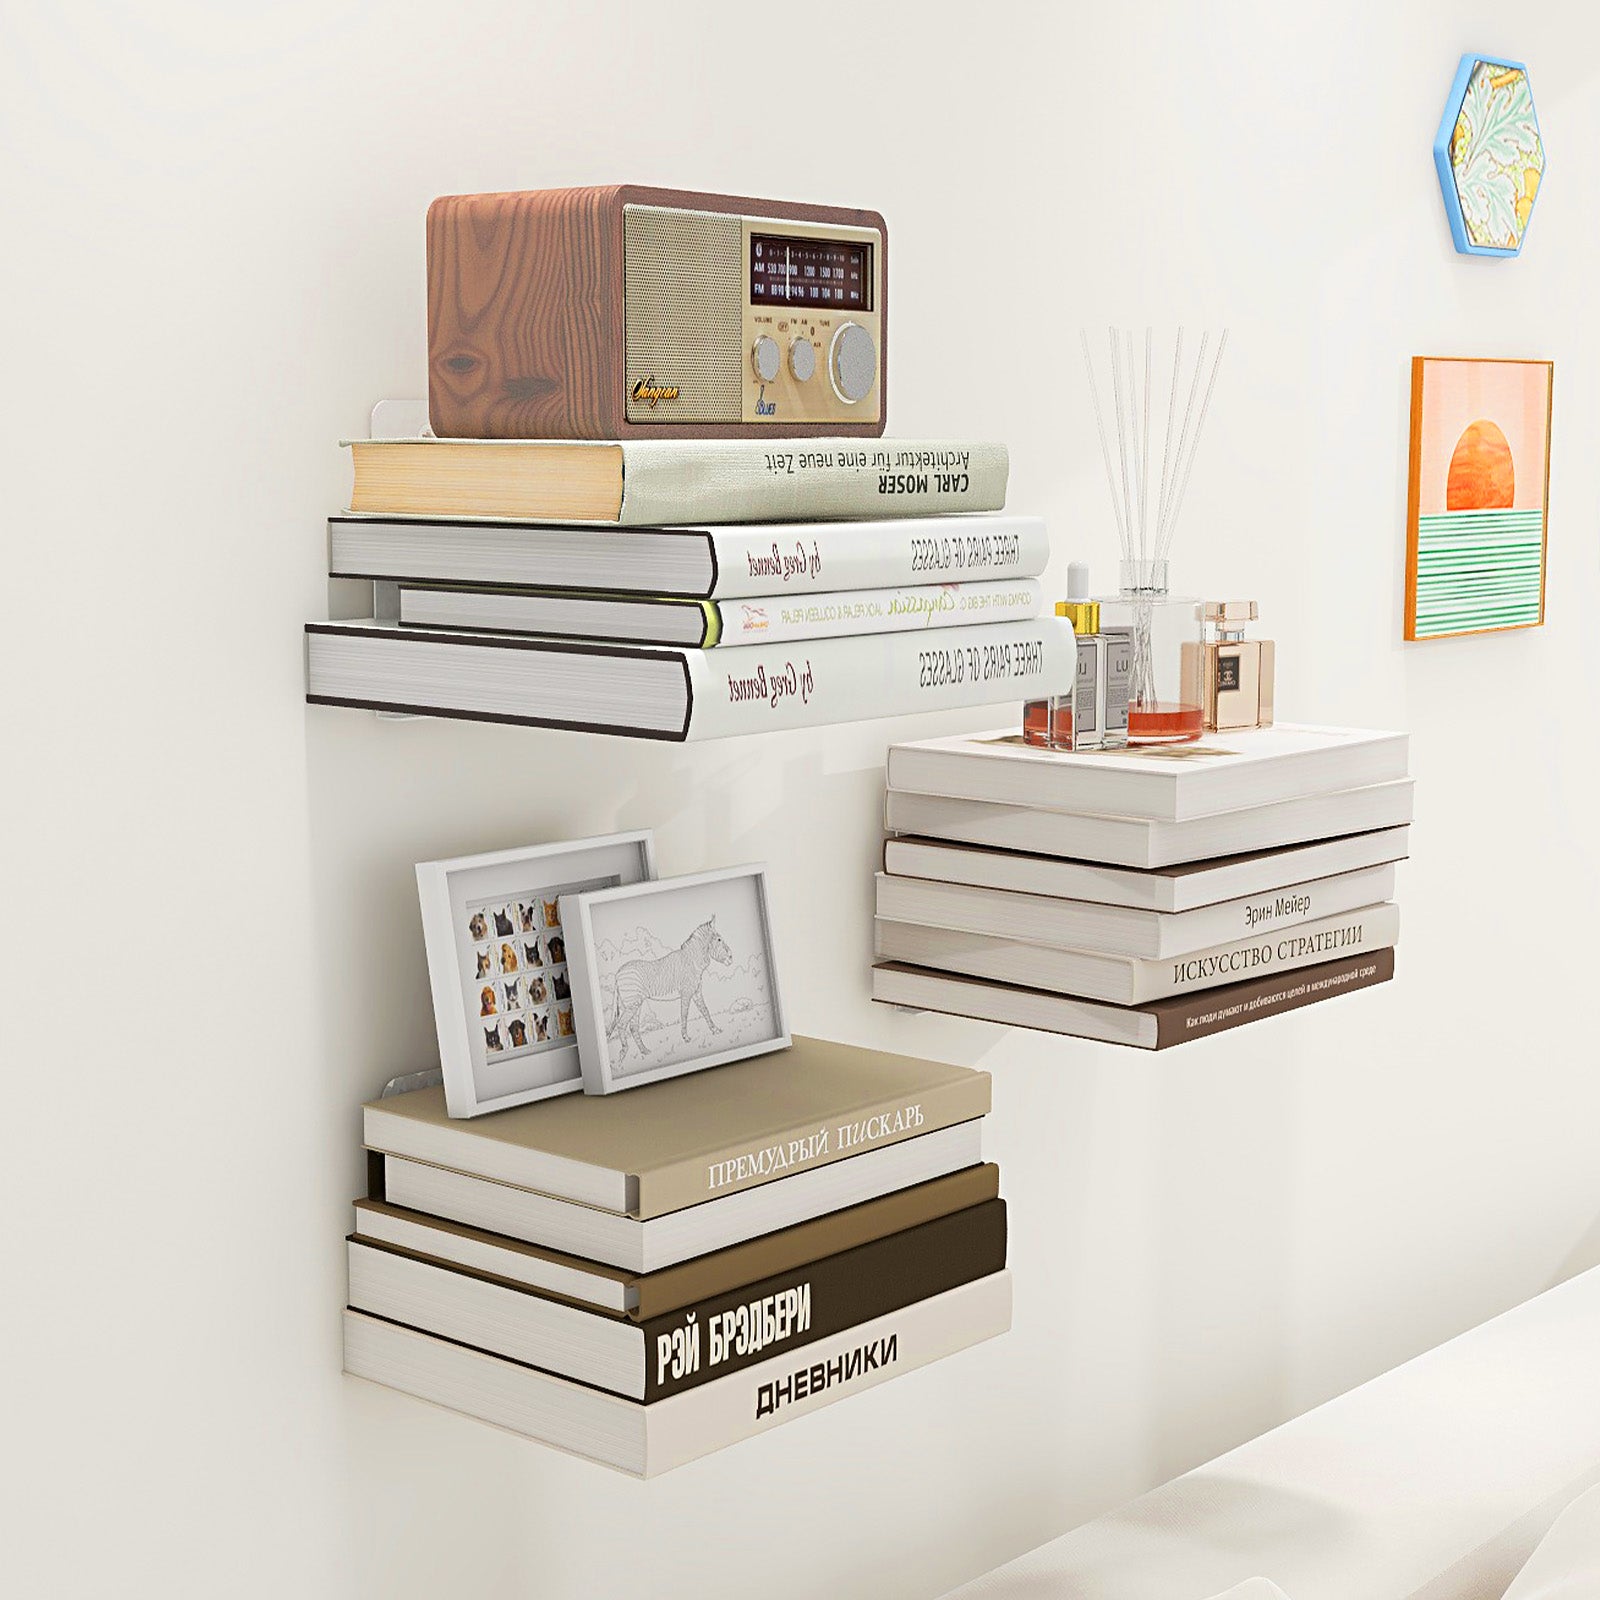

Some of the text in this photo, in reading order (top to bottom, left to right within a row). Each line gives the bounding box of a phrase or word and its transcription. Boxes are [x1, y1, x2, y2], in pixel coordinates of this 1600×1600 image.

[754, 262, 765, 273] AM
[754, 283, 765, 294] FM
[764, 450, 970, 474] Architektur für eine neue Zeit
[878, 473, 970, 495] CARL MOSER
[1245, 894, 1312, 930] Эрин Мейер
[1173, 924, 1363, 984] ИСКУССТВО СТРАТЕГИИ
[1186, 1016, 1200, 1029] Как
[1199, 1010, 1218, 1026] люди
[1217, 1003, 1244, 1021] думают
[1248, 989, 1286, 1011] добиваются
[1287, 983, 1306, 1000] целей
[1311, 968, 1359, 992] международной
[1359, 964, 1377, 980] среде
[708, 1127, 830, 1190] ПРЕМУДРЫЙ
[656, 1281, 812, 1386] РЭЙ БРЭДБЕРИ
[755, 1333, 899, 1420] ДНЕВНИКИ
